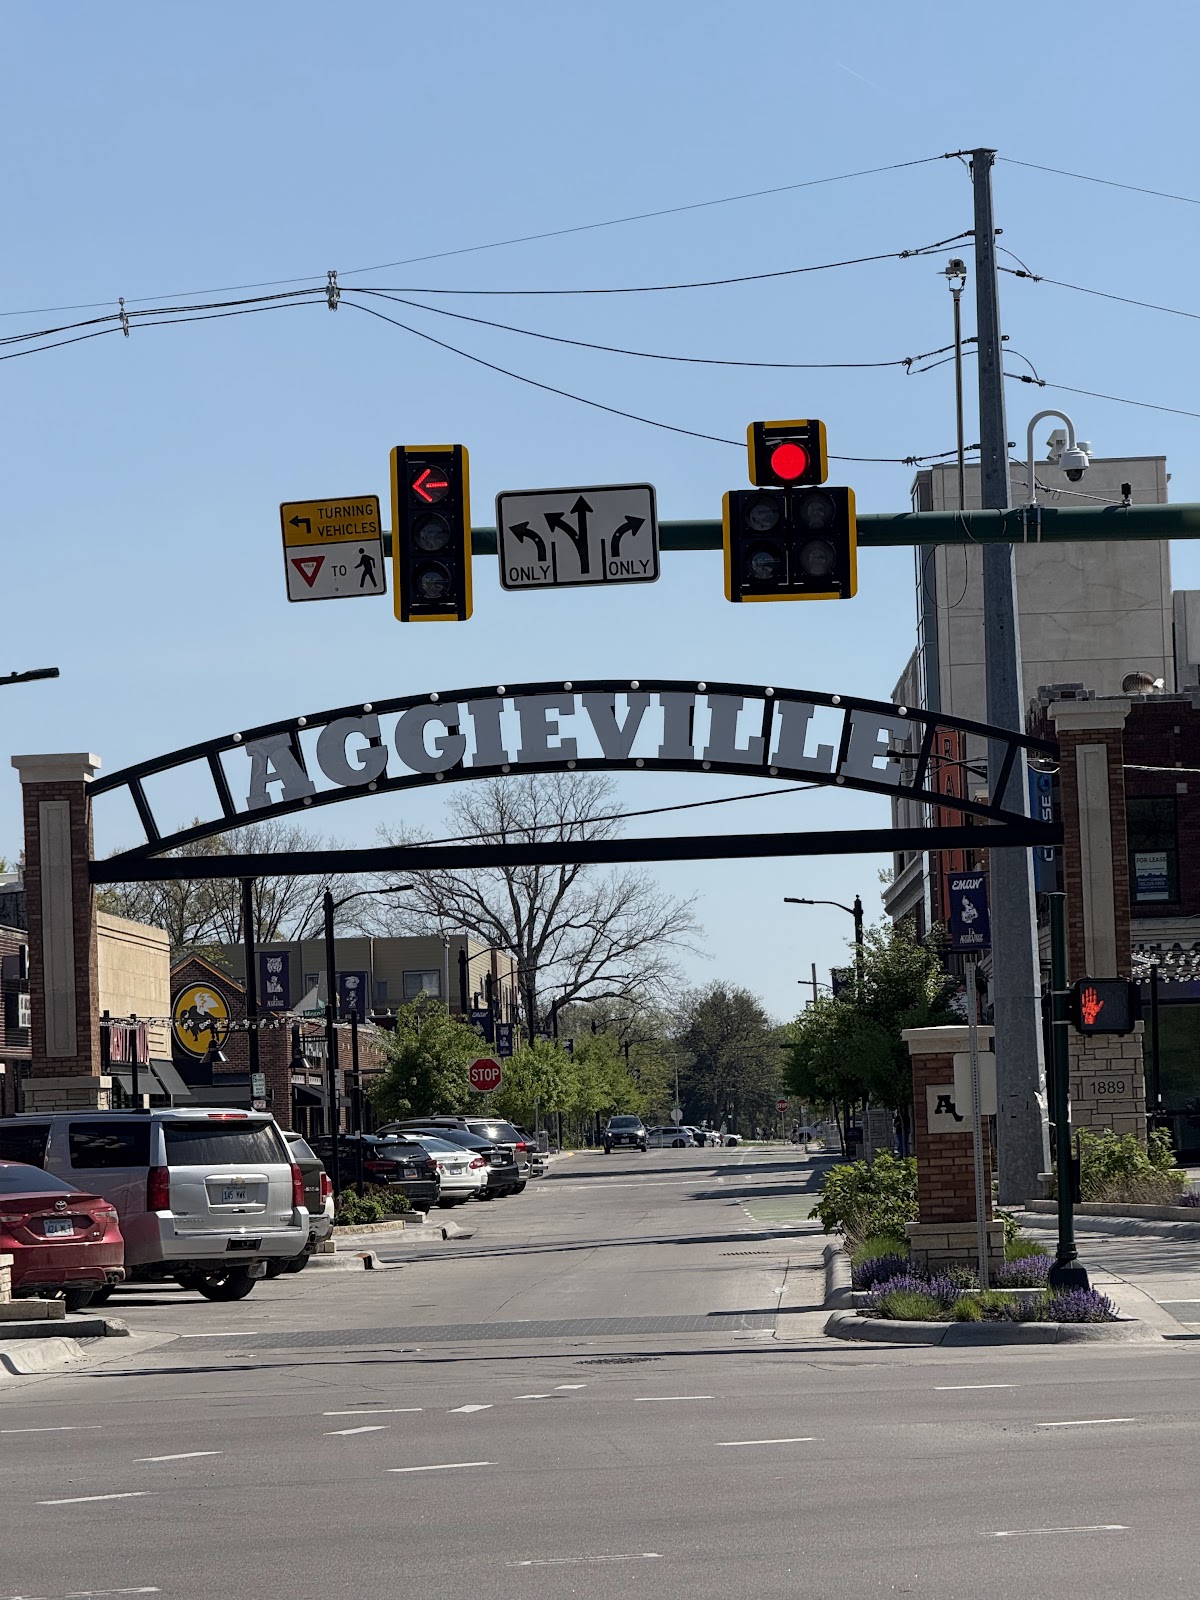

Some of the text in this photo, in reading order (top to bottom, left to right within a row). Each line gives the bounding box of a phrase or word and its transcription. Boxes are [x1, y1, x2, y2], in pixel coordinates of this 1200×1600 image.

[317, 504, 373, 520] TURNING
[317, 521, 377, 537] VEHICLES
[331, 565, 347, 577] TO
[509, 565, 551, 582] ONLY
[608, 559, 650, 576] ONLY
[245, 691, 911, 811] AGGIEVILLE
[1041, 795, 1054, 862] CSE
[951, 877, 983, 891] EMAW
[471, 1068, 500, 1082] STOP
[1089, 1080, 1125, 1095] 1889
